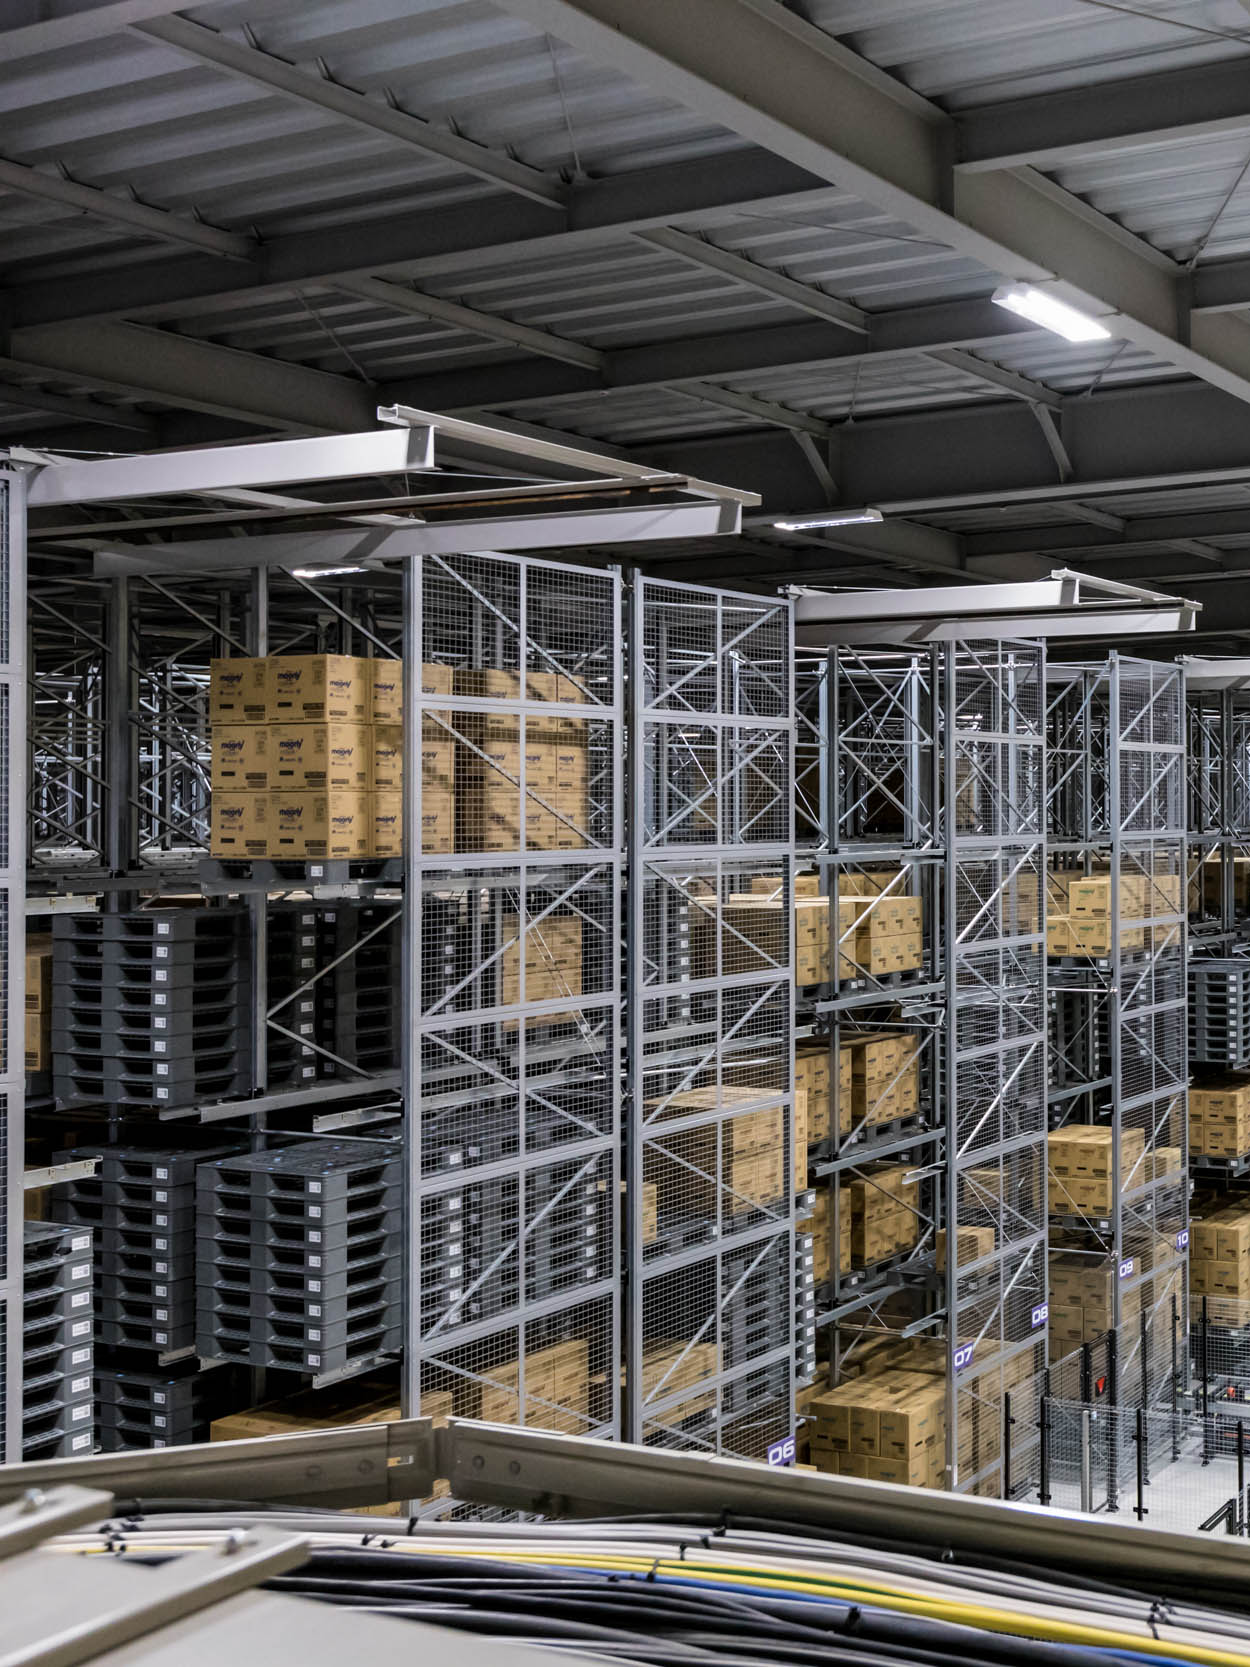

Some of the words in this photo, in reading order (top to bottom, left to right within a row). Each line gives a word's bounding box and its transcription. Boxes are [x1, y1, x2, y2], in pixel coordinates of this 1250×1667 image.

[1178, 1232, 1189, 1246] 10
[1119, 1260, 1134, 1278] 09
[1032, 1305, 1048, 1325] 08
[954, 1345, 973, 1366] 07
[768, 1440, 794, 1465] 06
